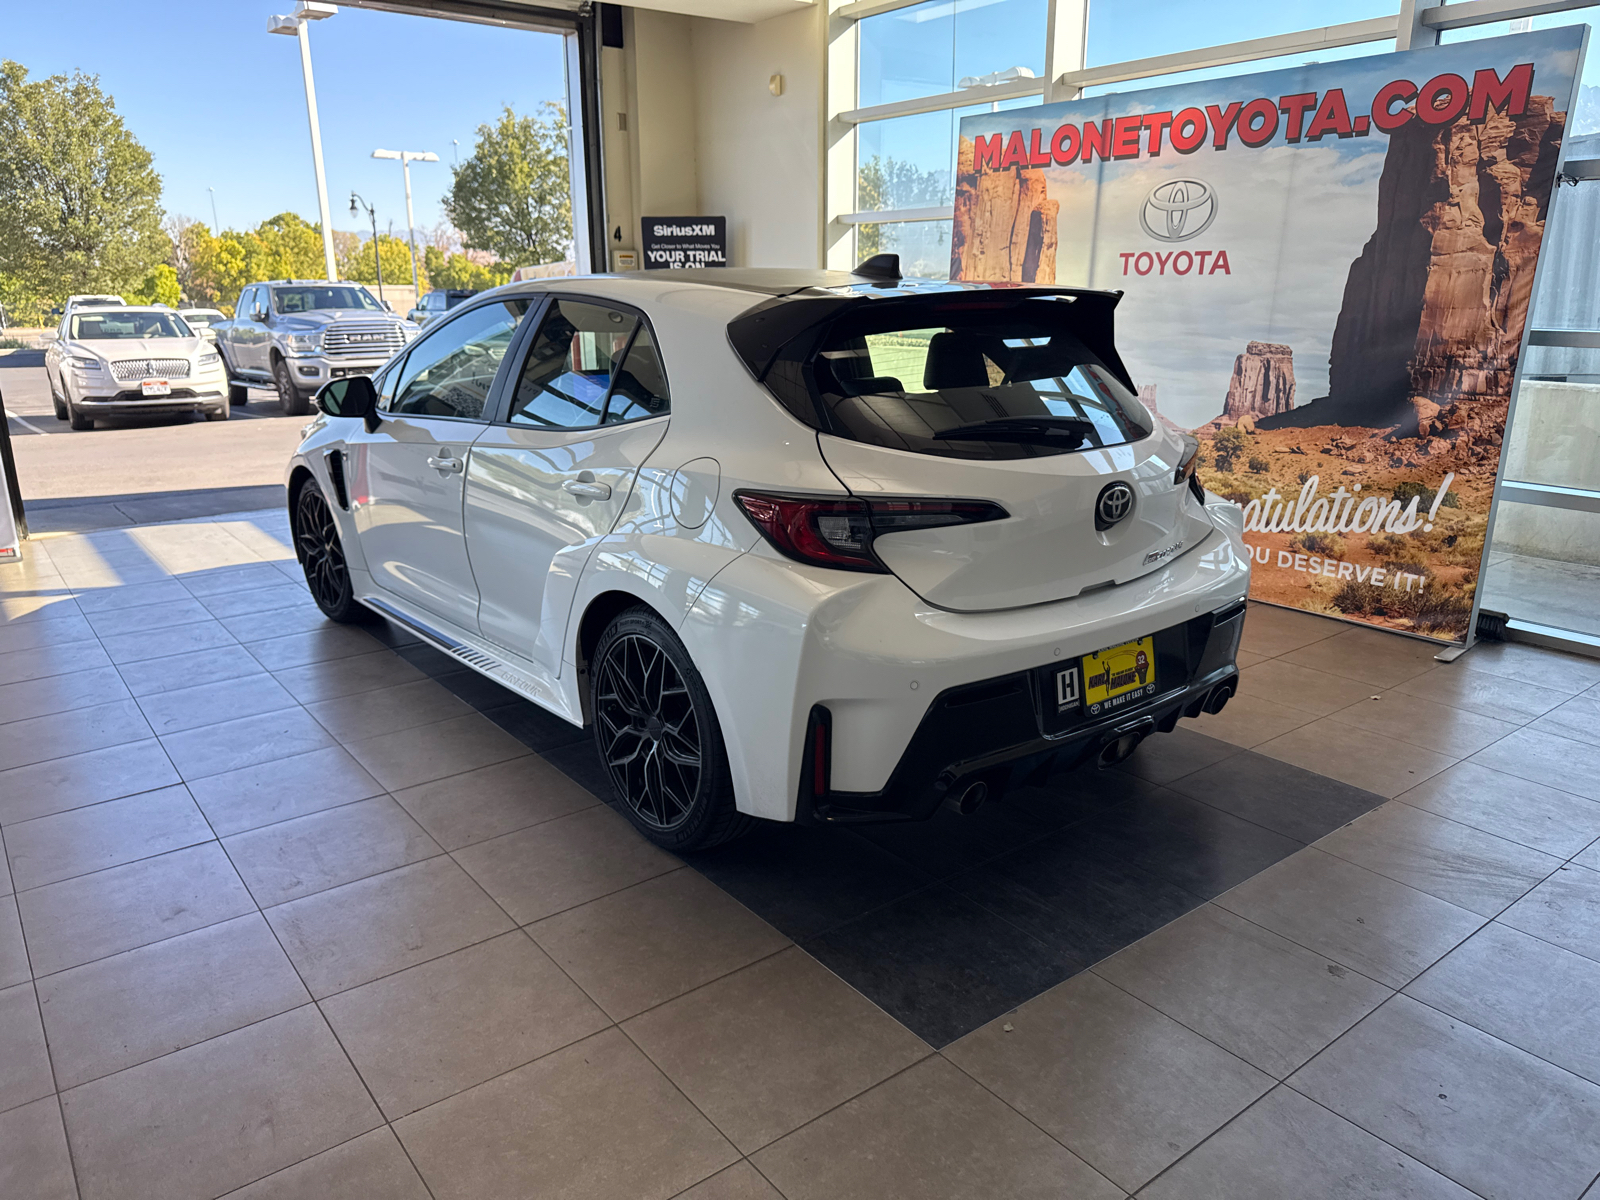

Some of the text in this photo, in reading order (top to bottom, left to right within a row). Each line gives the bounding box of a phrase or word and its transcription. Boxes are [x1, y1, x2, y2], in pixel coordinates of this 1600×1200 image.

[973, 63, 1535, 173] MALONETOYOTA.COM
[613, 225, 622, 242] 4
[653, 224, 715, 236] SiriusXM
[647, 250, 685, 262] YOUR
[687, 250, 726, 262] TRIAL
[1119, 250, 1231, 276] TOYOTA
[1231, 472, 1455, 534] atulations!
[1277, 550, 1387, 587] DESERVE
[1393, 571, 1426, 594] IT!
[1137, 654, 1146, 665] 32
[1103, 689, 1143, 709] WE MAKE IT EASY
